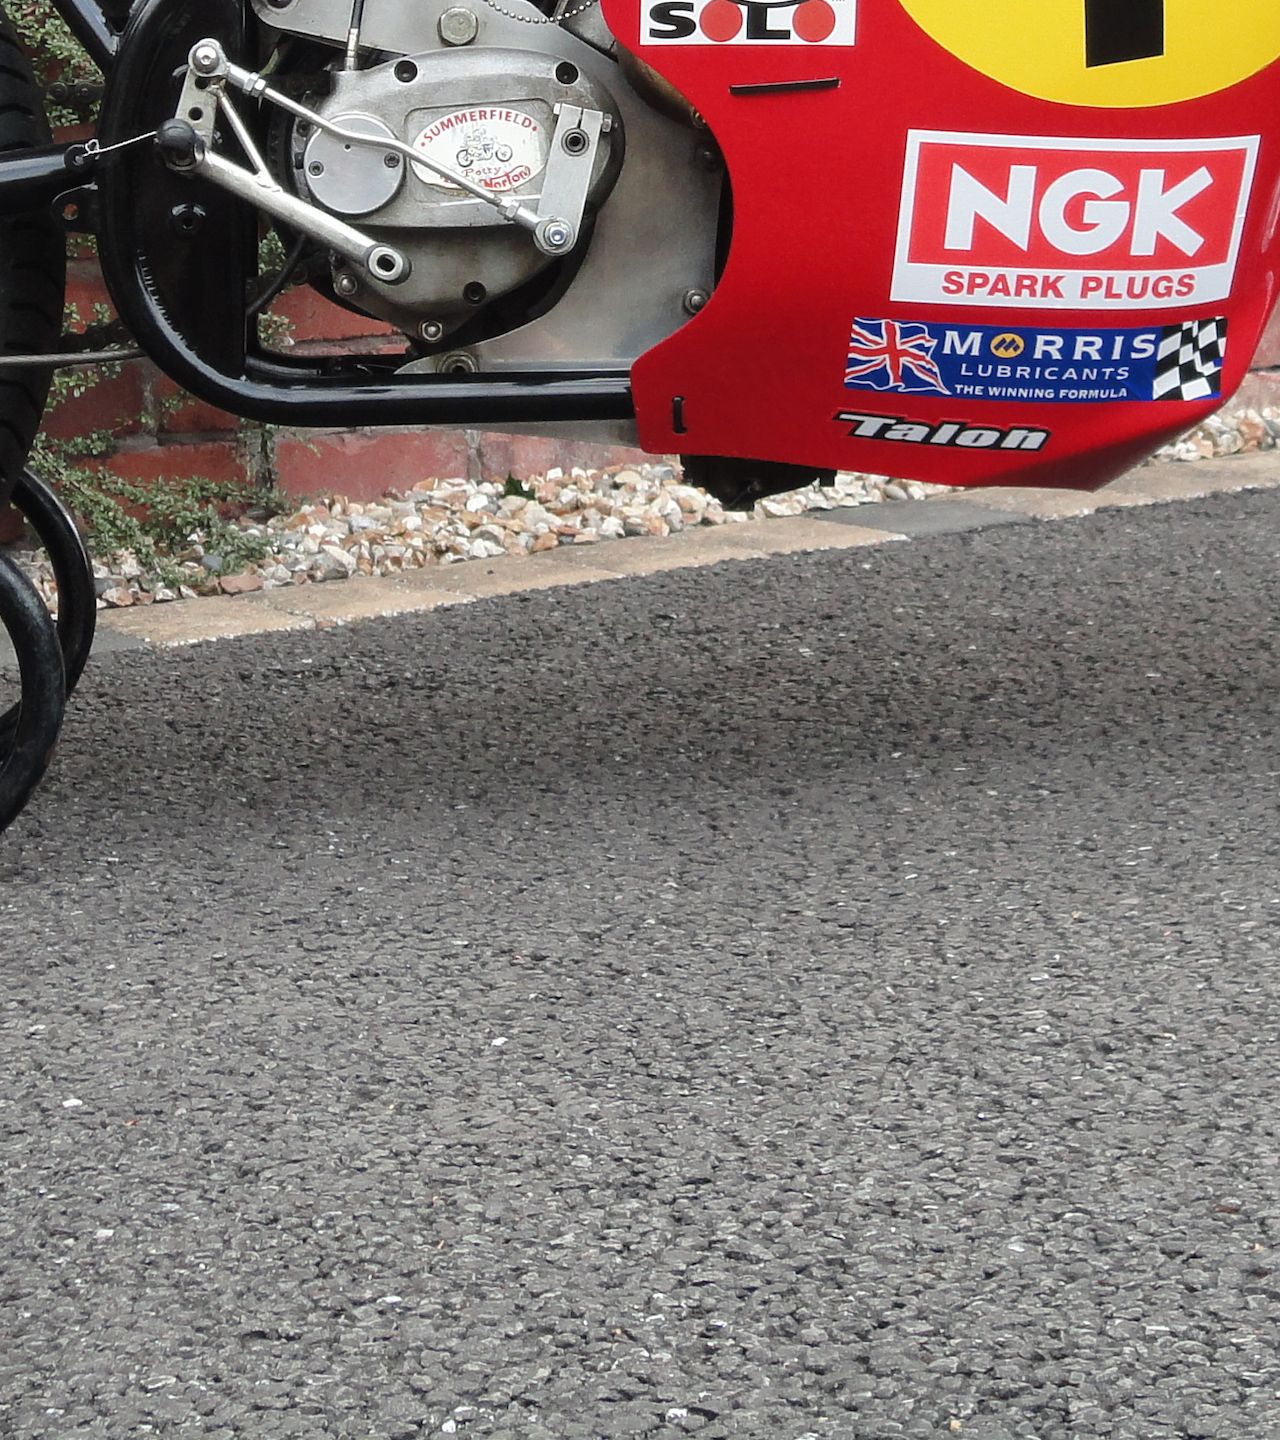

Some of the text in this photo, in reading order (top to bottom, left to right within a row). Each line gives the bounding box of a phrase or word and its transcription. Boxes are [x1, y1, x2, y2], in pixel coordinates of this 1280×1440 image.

[423, 110, 532, 143] SUMMERFIELD
[480, 165, 531, 189] Norton
[944, 163, 1214, 257] NGK
[942, 272, 1196, 300] SPARK PLUGS
[943, 330, 1157, 361] MORRIS
[960, 363, 1130, 380] LUBRICANTS
[955, 385, 1128, 399] THE WINNING FORMULA
[838, 413, 1050, 450] Talon
